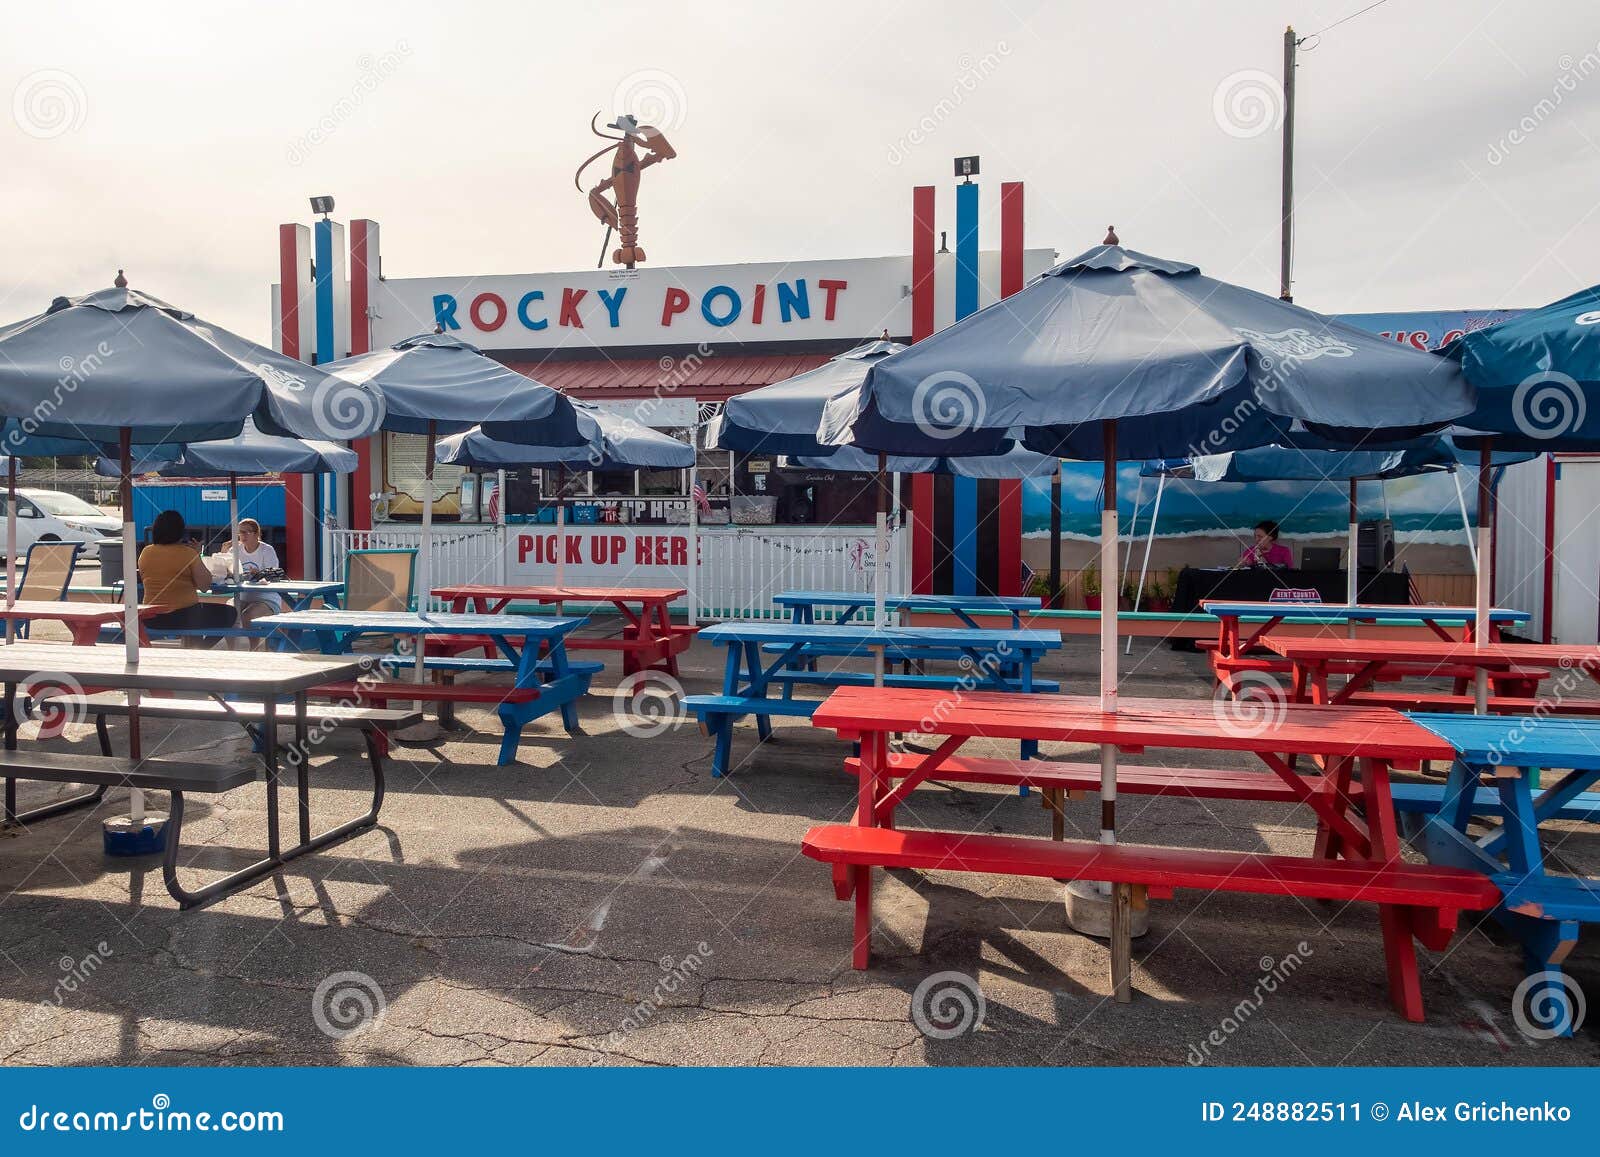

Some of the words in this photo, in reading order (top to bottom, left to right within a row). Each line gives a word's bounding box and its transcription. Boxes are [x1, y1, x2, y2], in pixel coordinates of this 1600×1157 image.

[432, 287, 628, 332] ROCKY
[661, 279, 848, 327] POINT
[650, 500, 691, 518] HER
[518, 534, 583, 565] PICK
[590, 535, 627, 565] UP
